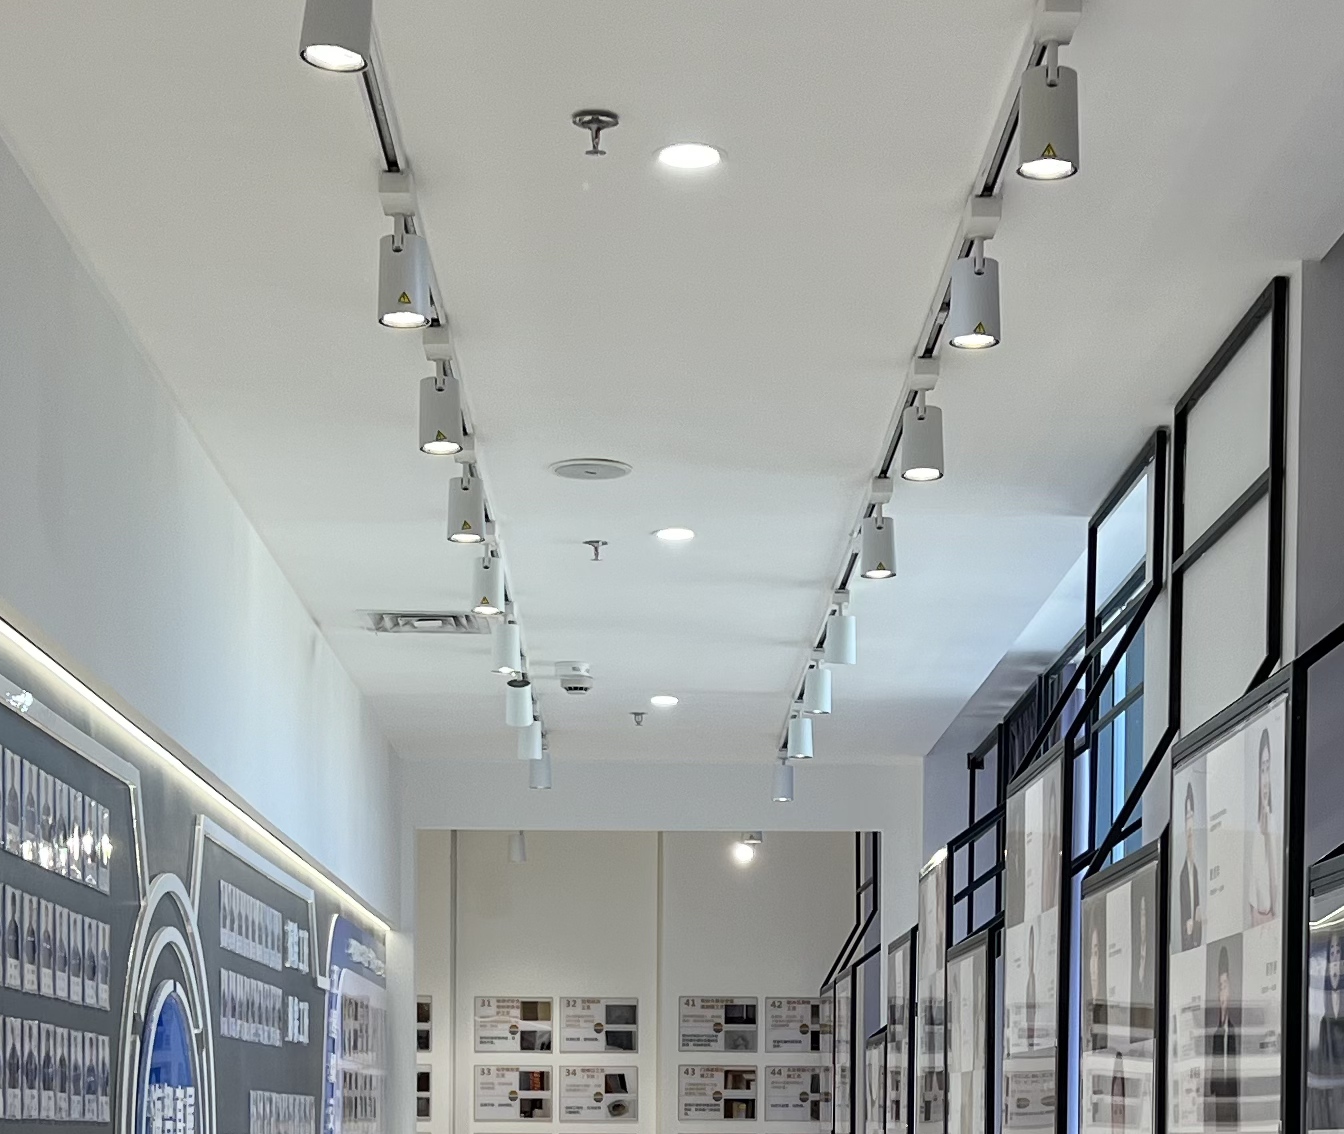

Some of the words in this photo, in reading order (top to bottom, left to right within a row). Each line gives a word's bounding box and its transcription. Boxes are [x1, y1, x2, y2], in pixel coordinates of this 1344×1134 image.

[480, 999, 492, 1007] 31
[565, 1000, 577, 1008] 32
[684, 999, 696, 1007] 41
[770, 1001, 782, 1009] 42
[480, 1068, 492, 1076] 33
[684, 1068, 696, 1076] 43
